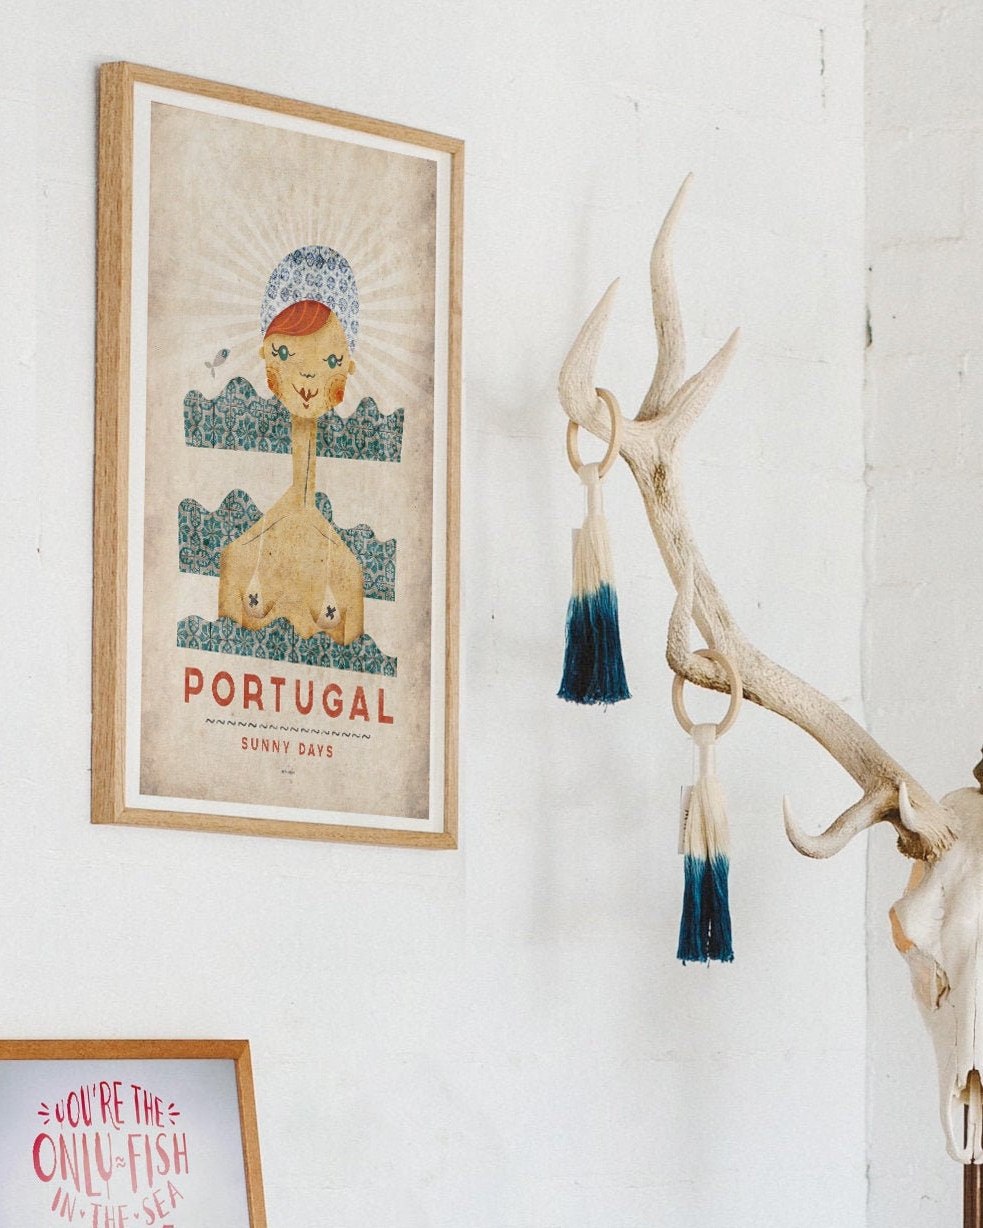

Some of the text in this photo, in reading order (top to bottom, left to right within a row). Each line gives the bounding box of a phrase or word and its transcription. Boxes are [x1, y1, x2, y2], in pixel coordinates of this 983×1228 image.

[184, 667, 394, 724] PORTUGAL
[241, 737, 333, 758] SUNNY DAYS
[55, 1081, 165, 1130] YOU'RE THE
[33, 1132, 189, 1199] ONLY FISH
[51, 1186, 77, 1222] IN
[142, 1180, 185, 1225] SEA
